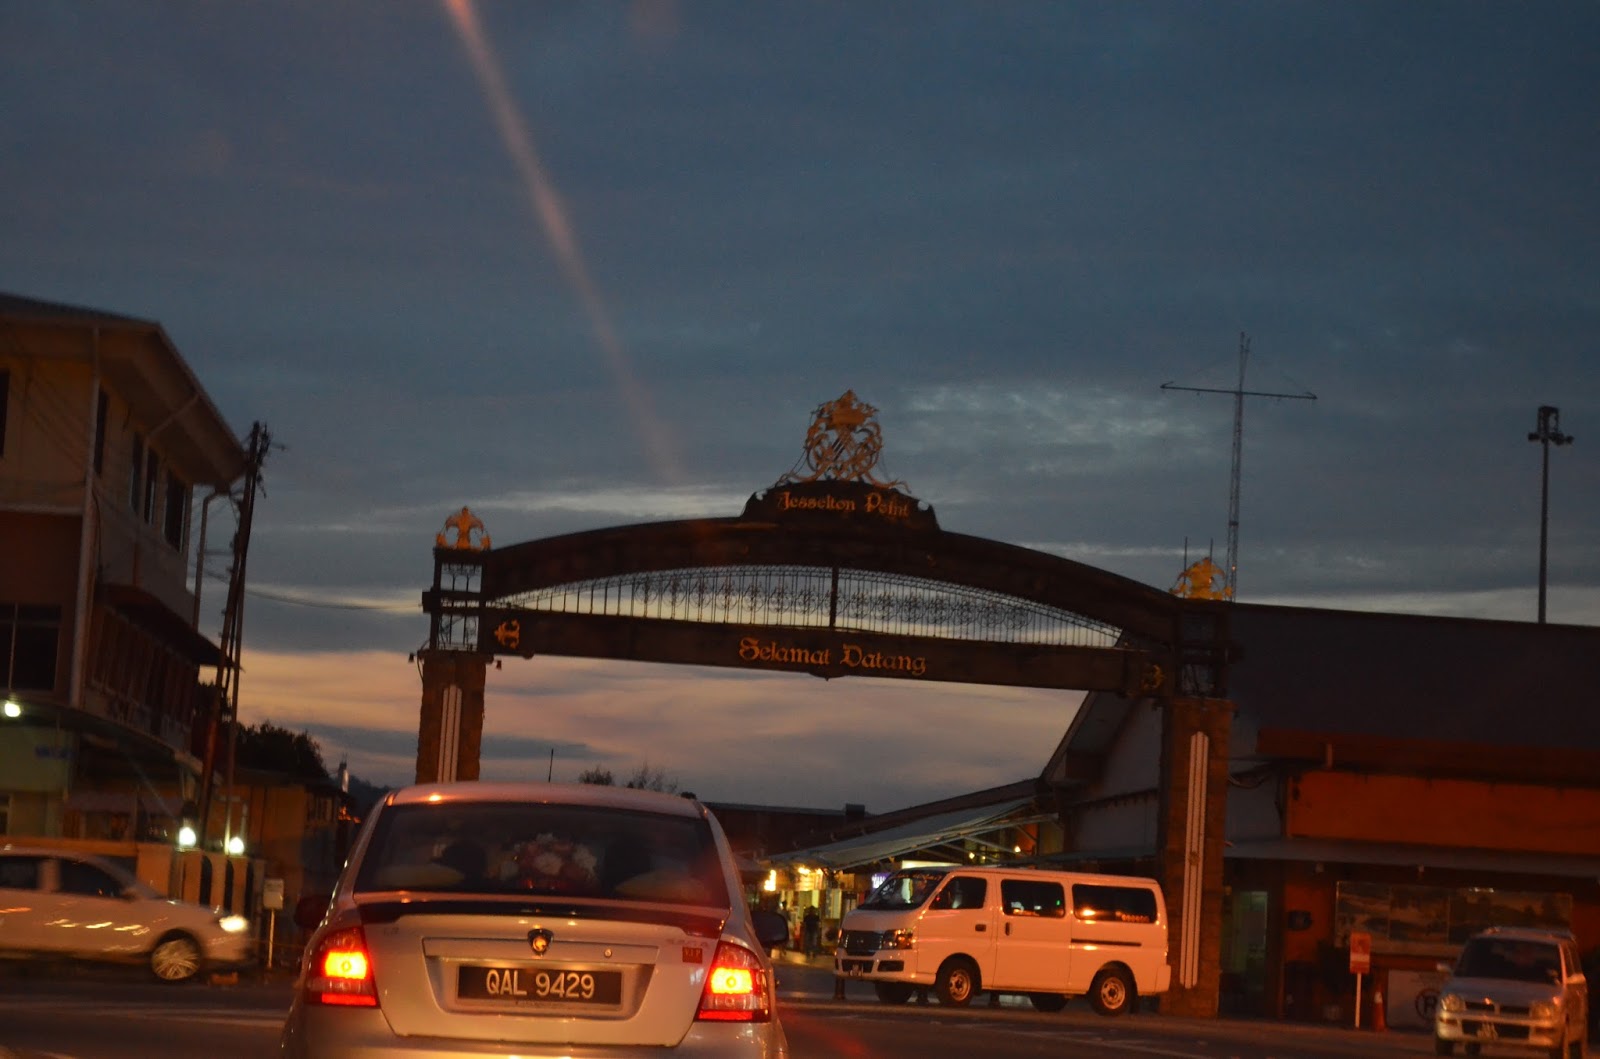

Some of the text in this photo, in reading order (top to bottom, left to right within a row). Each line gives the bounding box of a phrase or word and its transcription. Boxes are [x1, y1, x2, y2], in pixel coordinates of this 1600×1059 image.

[777, 489, 910, 518] Jesselton Point
[738, 636, 927, 676] Selamat Datang
[486, 969, 595, 999] QAL 9429
